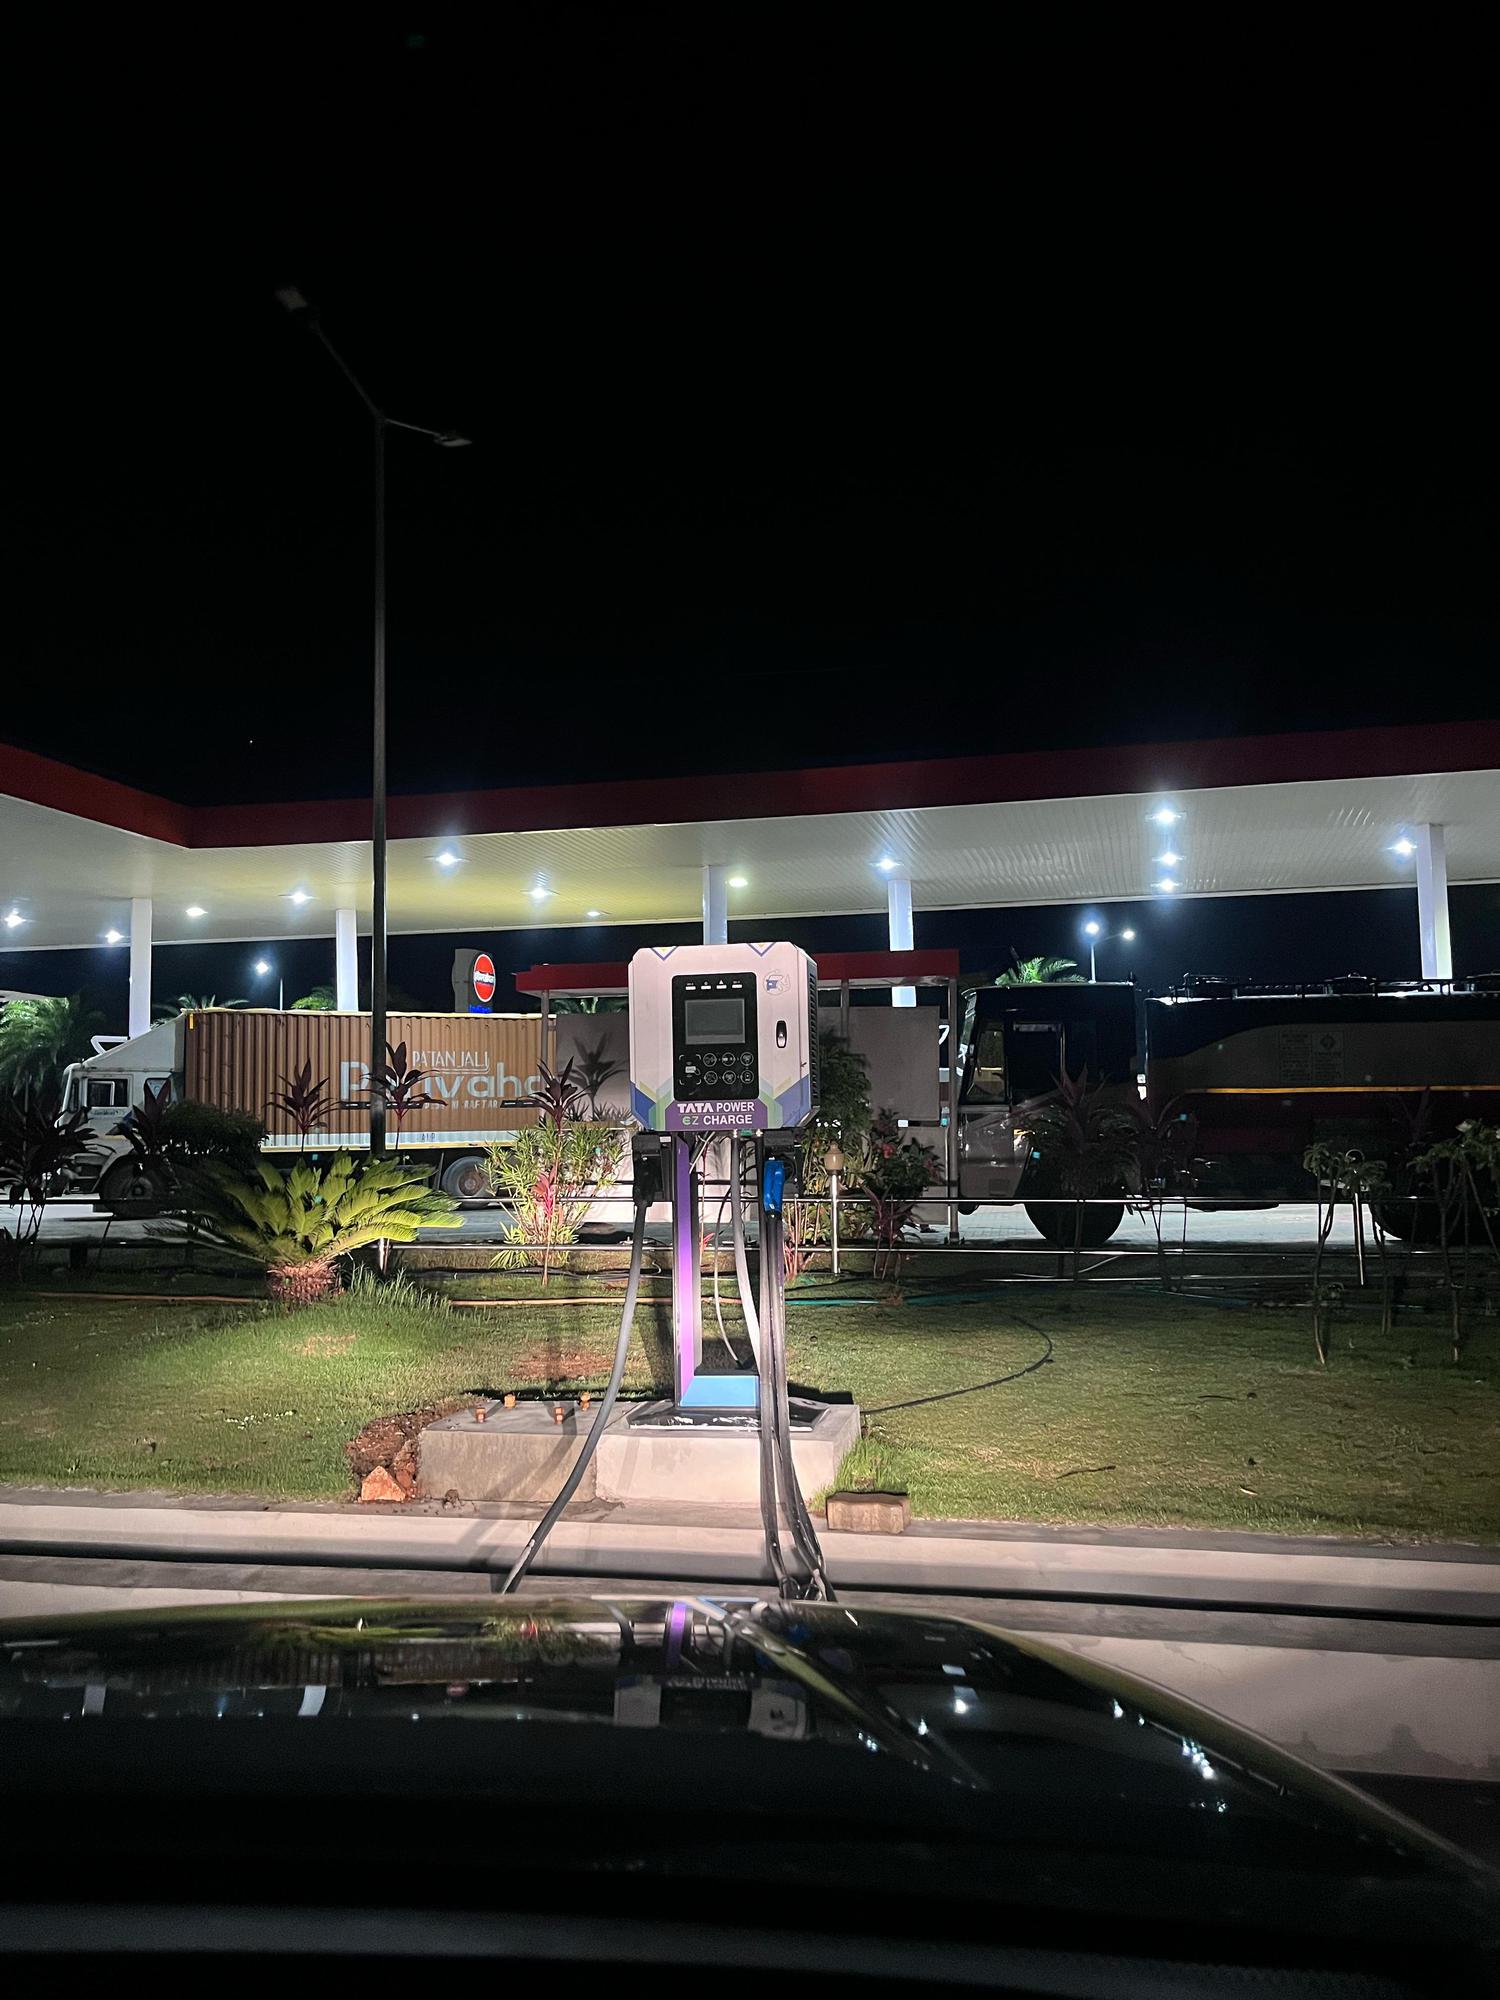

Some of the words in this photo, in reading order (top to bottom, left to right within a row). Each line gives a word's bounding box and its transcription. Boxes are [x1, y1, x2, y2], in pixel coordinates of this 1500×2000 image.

[412, 1051, 489, 1068] PATANJALI
[677, 1102, 714, 1113] TATA
[716, 1101, 755, 1112] POWER
[703, 1114, 753, 1125] CHARGE
